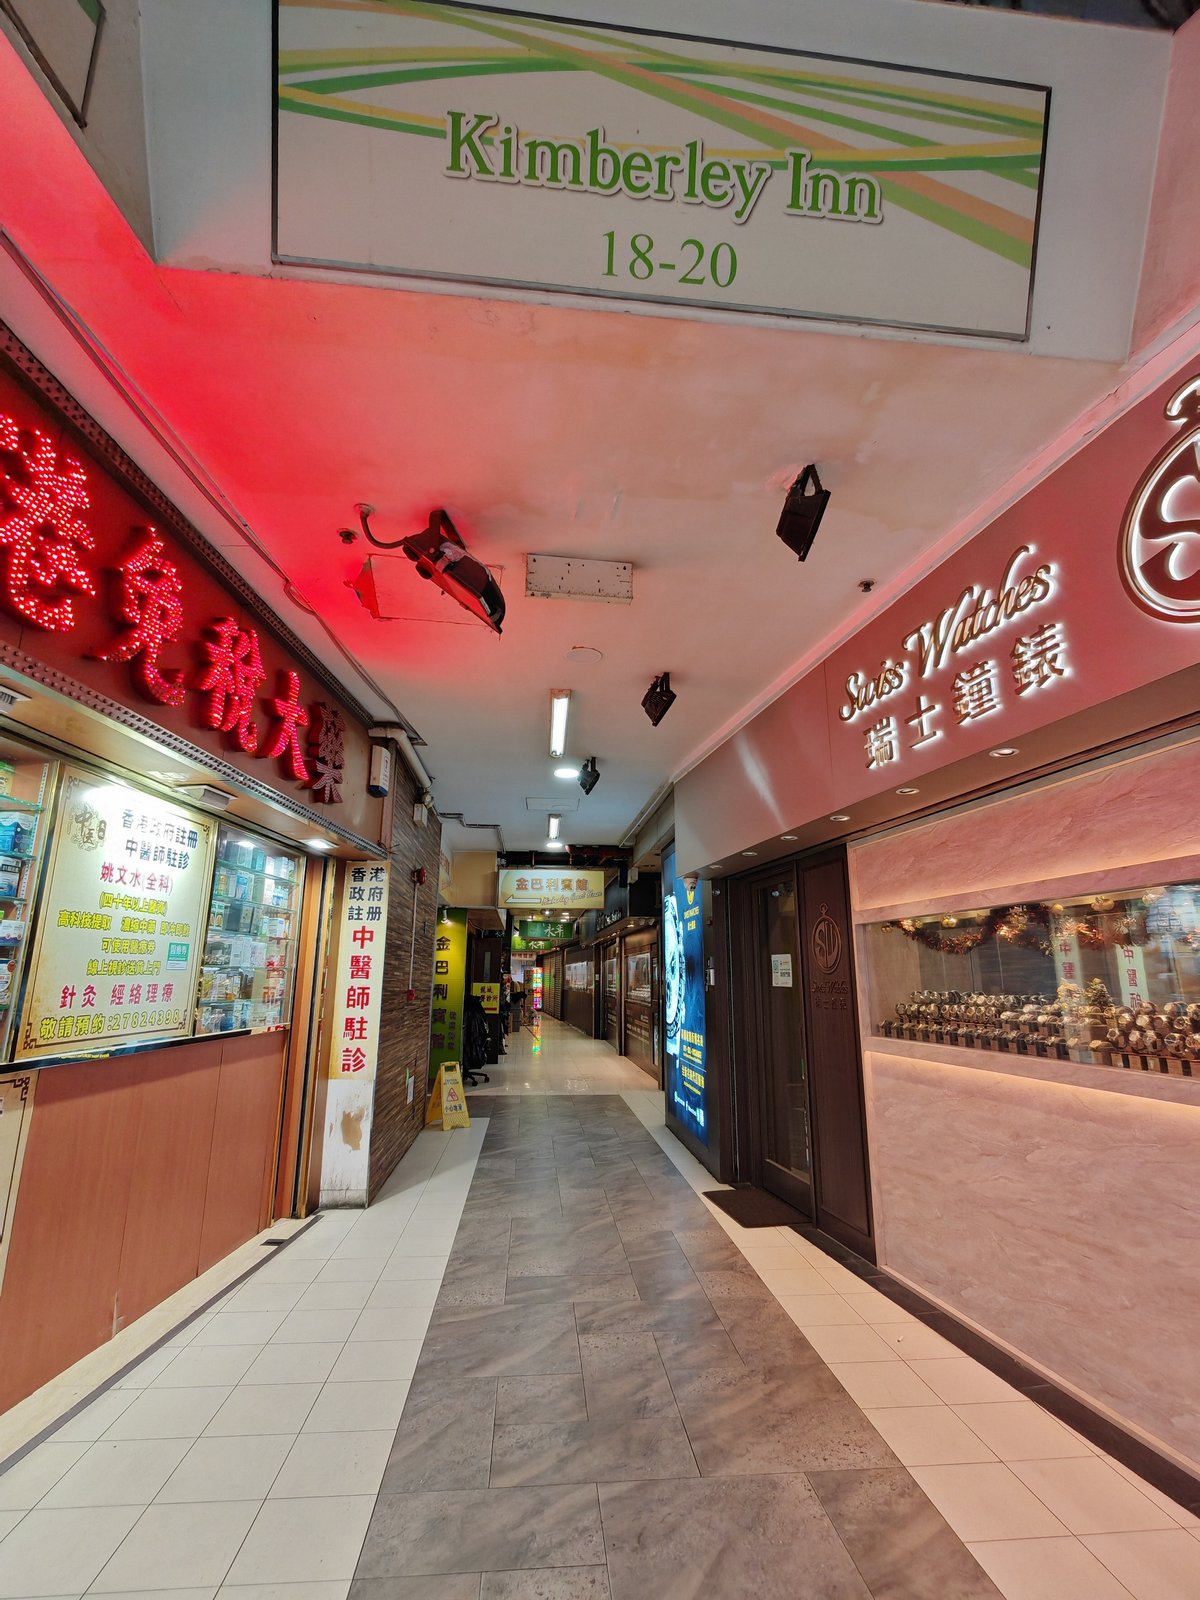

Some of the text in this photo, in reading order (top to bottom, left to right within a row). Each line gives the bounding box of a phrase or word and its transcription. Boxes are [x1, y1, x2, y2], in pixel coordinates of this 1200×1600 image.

[446, 111, 881, 223] Kimberley Inn
[600, 229, 738, 288] 18-20
[839, 545, 1055, 722] Swiss Watches
[863, 623, 1068, 769] 瑞士鐘錶
[125, 837, 190, 870] 中醫師駐診
[99, 861, 174, 897] 姚文水(全科)
[350, 866, 385, 883] 香港
[348, 886, 384, 902] 政府
[57, 909, 112, 930] 高科技提取
[59, 982, 174, 1009] 針灸 經絡理療
[341, 925, 375, 1073] 中醫師駐診
